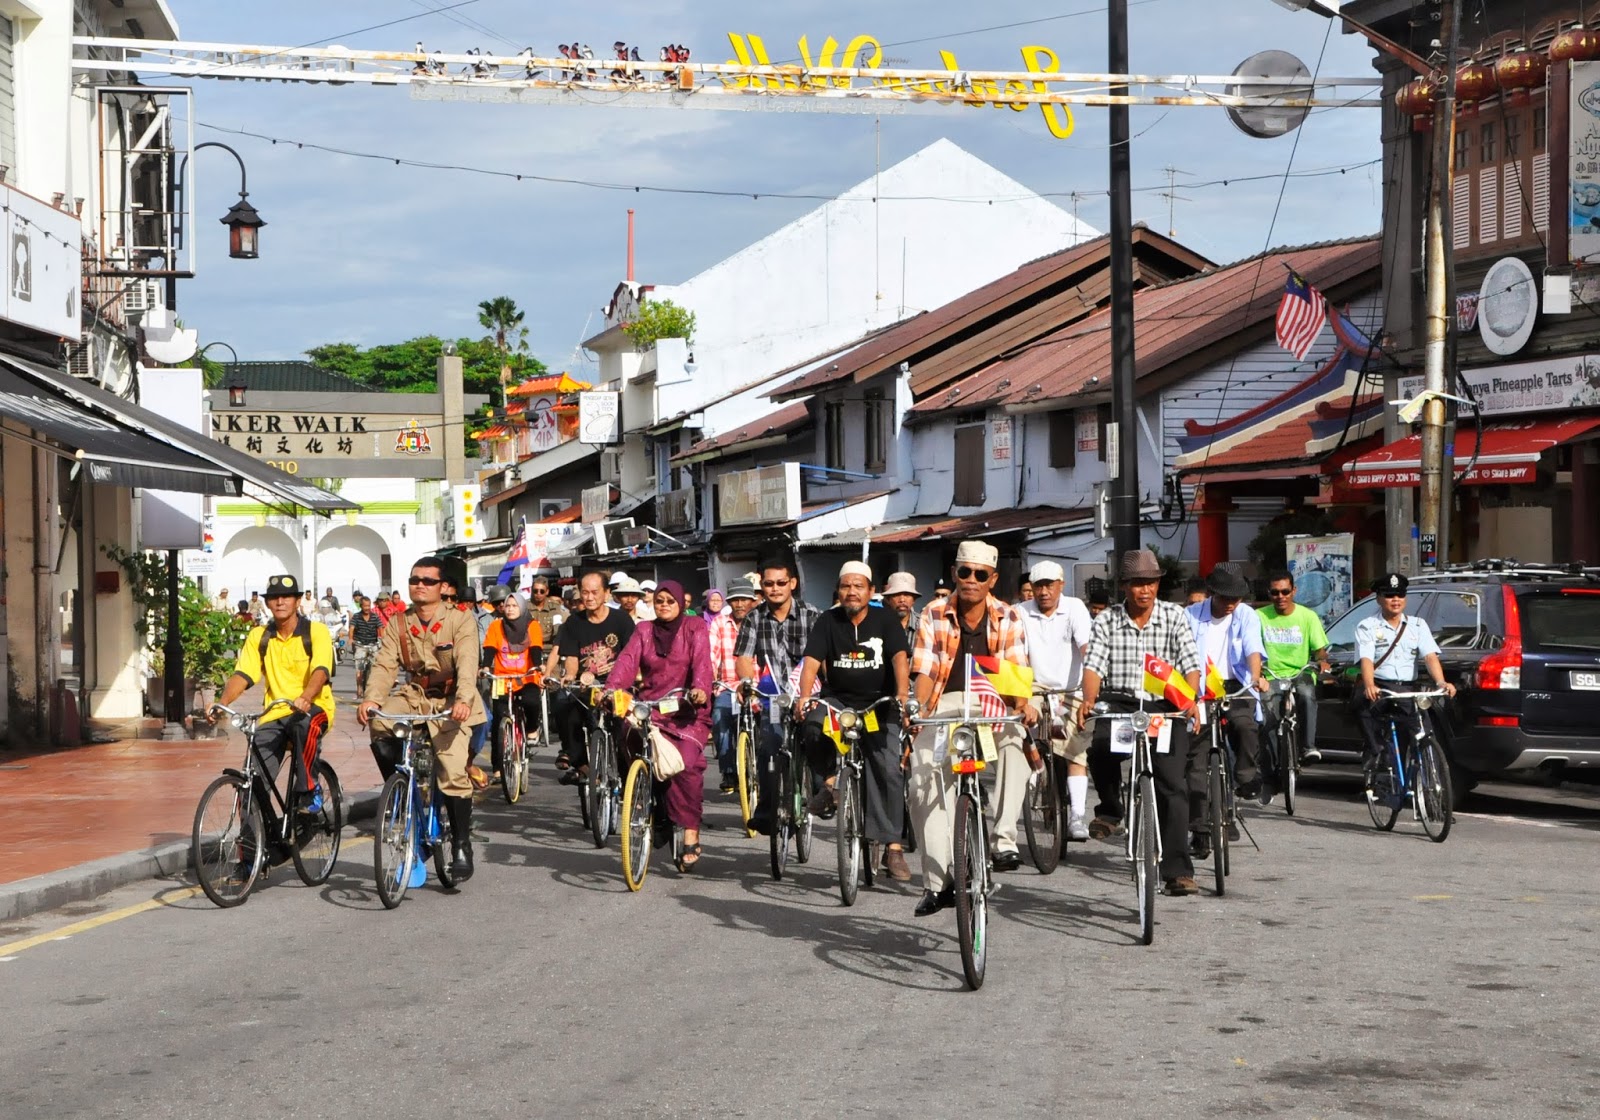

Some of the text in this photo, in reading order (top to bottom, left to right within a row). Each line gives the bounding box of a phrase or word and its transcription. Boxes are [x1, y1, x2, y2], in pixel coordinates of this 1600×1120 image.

[1492, 374, 1543, 394] Pineapple
[1546, 372, 1573, 387] Tarts
[1457, 399, 1485, 414] Houe
[293, 415, 368, 434] WALK
[550, 527, 571, 536] CLM
